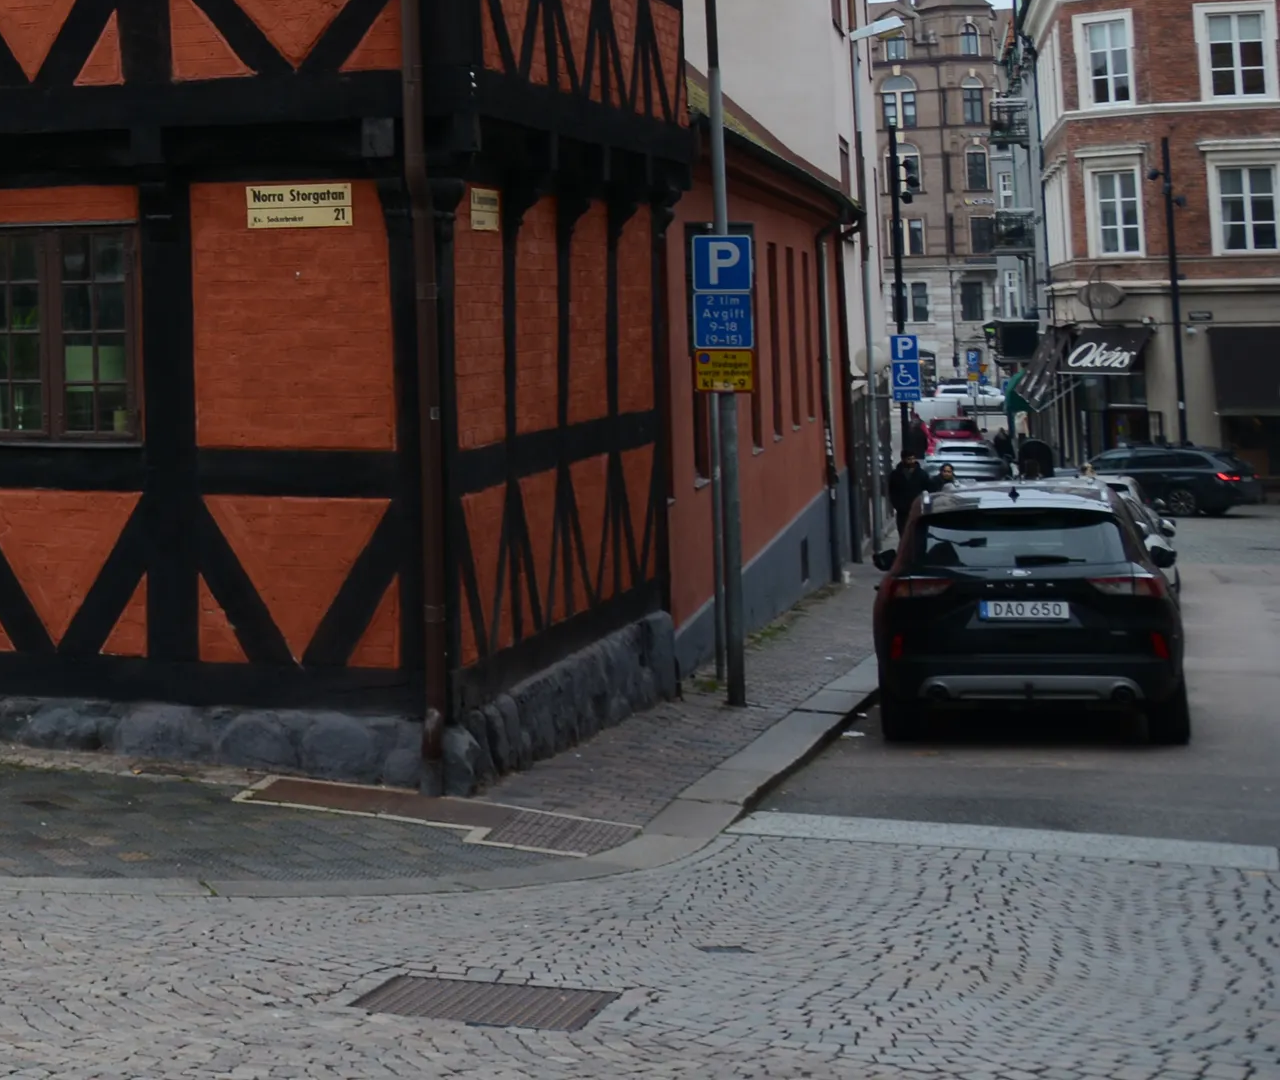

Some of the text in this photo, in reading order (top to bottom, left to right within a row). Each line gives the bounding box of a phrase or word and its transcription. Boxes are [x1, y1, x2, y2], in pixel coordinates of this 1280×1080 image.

[253, 189, 345, 204] Norra Storgatan
[334, 208, 345, 220] 21
[709, 242, 740, 285] P
[706, 295, 740, 306] 2 tim
[703, 308, 744, 321] Avgift
[709, 321, 738, 332] 9-18
[704, 334, 743, 345] (9-15)
[897, 337, 913, 358] P
[994, 603, 1062, 616] DAO 650
